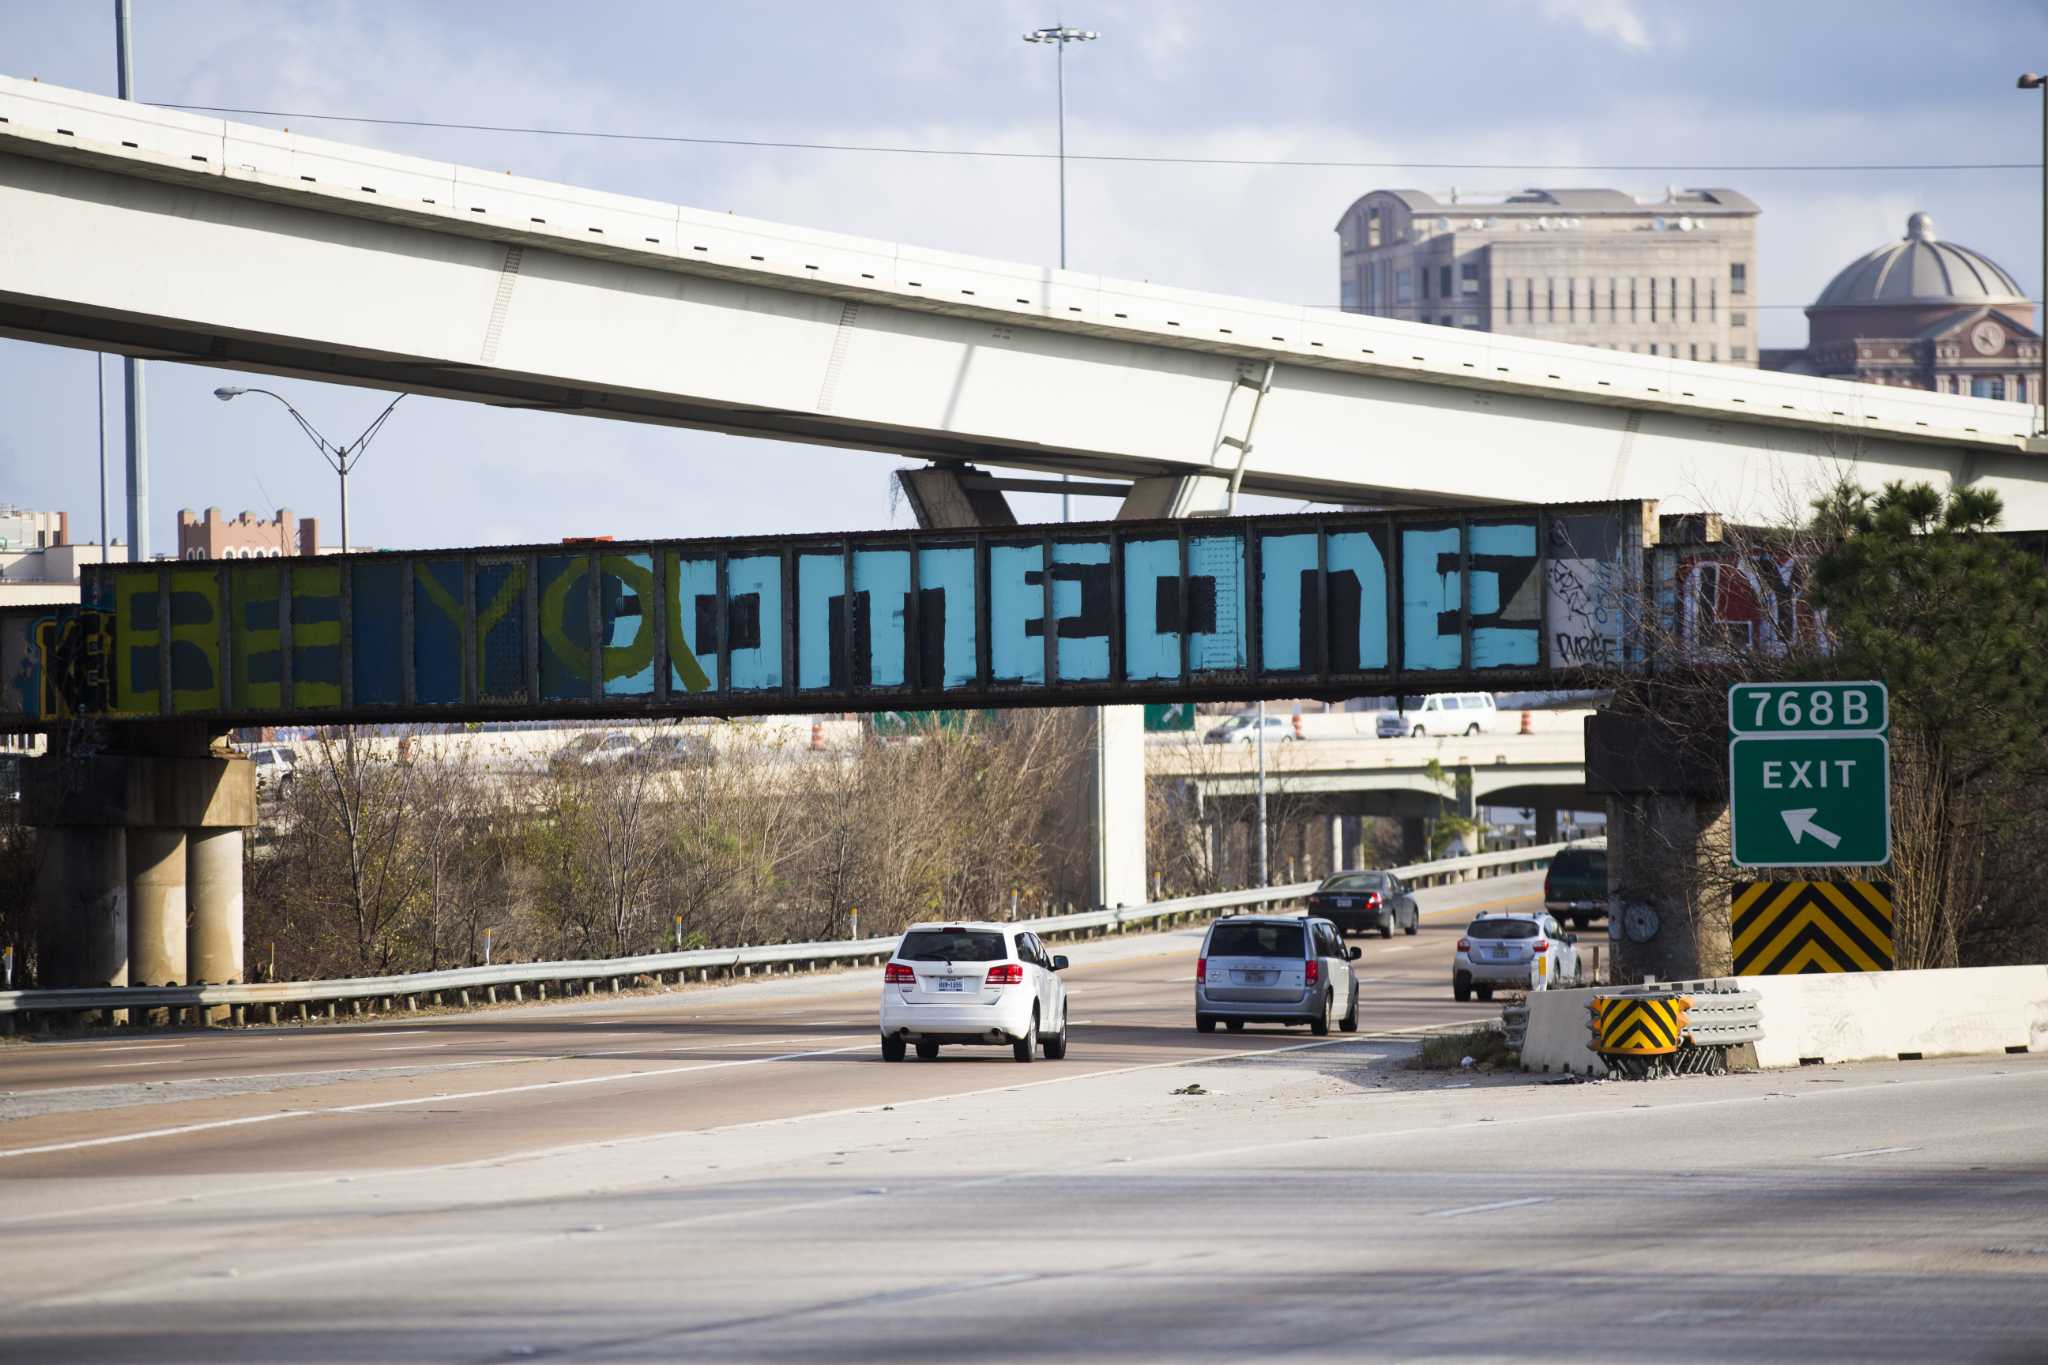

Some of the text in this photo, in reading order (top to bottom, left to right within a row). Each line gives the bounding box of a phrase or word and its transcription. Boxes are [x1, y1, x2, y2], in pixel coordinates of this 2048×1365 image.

[114, 564, 342, 714] BE
[1748, 690, 1869, 727] 768B
[1763, 760, 1856, 789] EXIT
